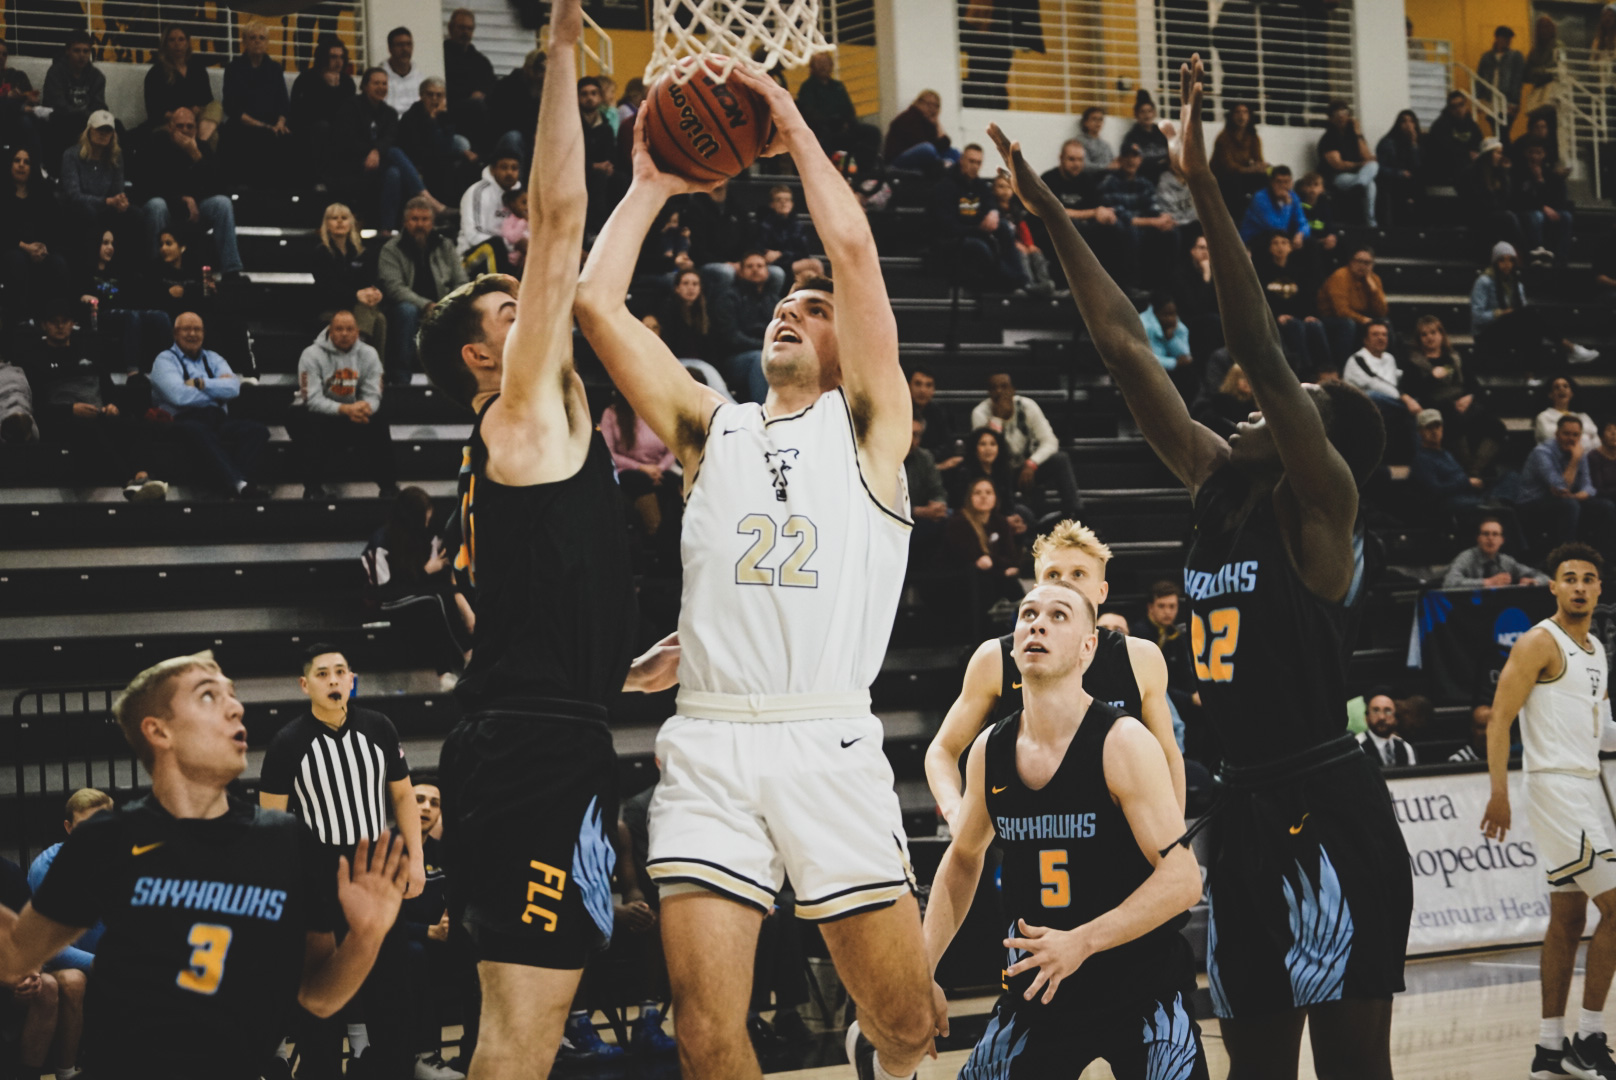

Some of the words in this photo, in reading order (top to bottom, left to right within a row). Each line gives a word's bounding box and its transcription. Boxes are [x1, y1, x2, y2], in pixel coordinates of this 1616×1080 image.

[667, 83, 721, 160] Wilson
[735, 513, 819, 589] 22
[996, 812, 1097, 841] SKYHAWKS
[130, 876, 288, 922] SKYHAWKS
[521, 859, 567, 933] FLC
[1038, 848, 1072, 909] 5
[175, 922, 233, 996] 3
